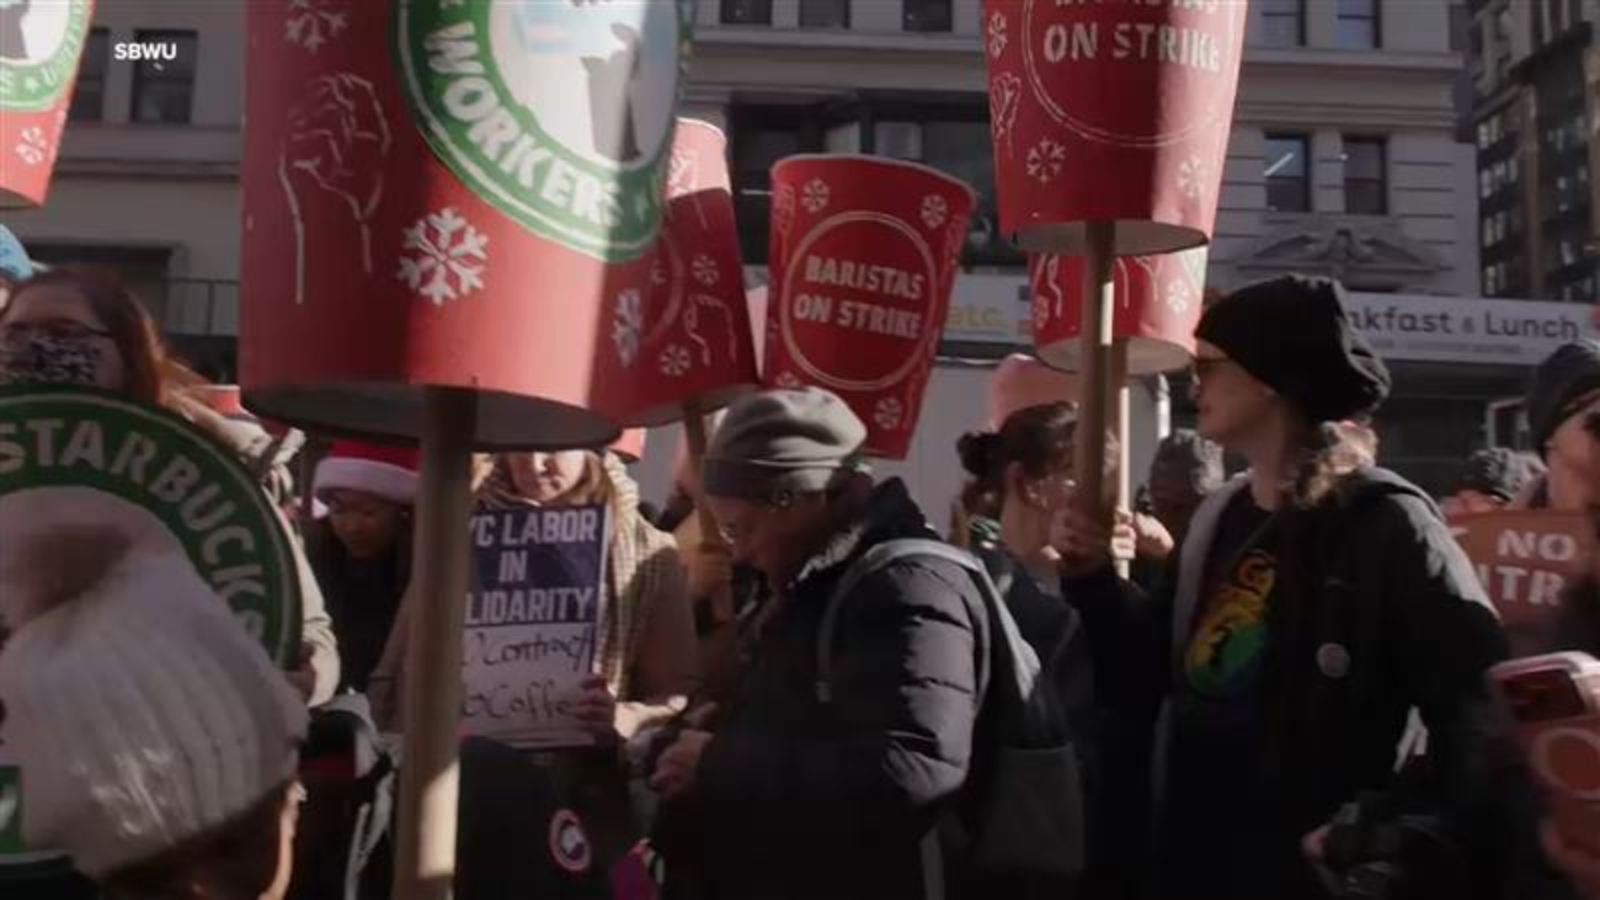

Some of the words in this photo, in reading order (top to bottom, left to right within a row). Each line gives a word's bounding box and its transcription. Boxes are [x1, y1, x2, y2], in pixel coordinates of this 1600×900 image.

[1043, 22, 1099, 63] ON
[1112, 23, 1221, 73] STRIKE
[804, 255, 924, 301] BARISTAS
[793, 293, 832, 323] ON
[837, 301, 922, 341] STRIKE
[1485, 310, 1580, 340] Lunch
[502, 508, 598, 546] LABOR
[1497, 529, 1575, 561] NO
[498, 550, 527, 582] IN
[465, 587, 594, 624] LIDARITY
